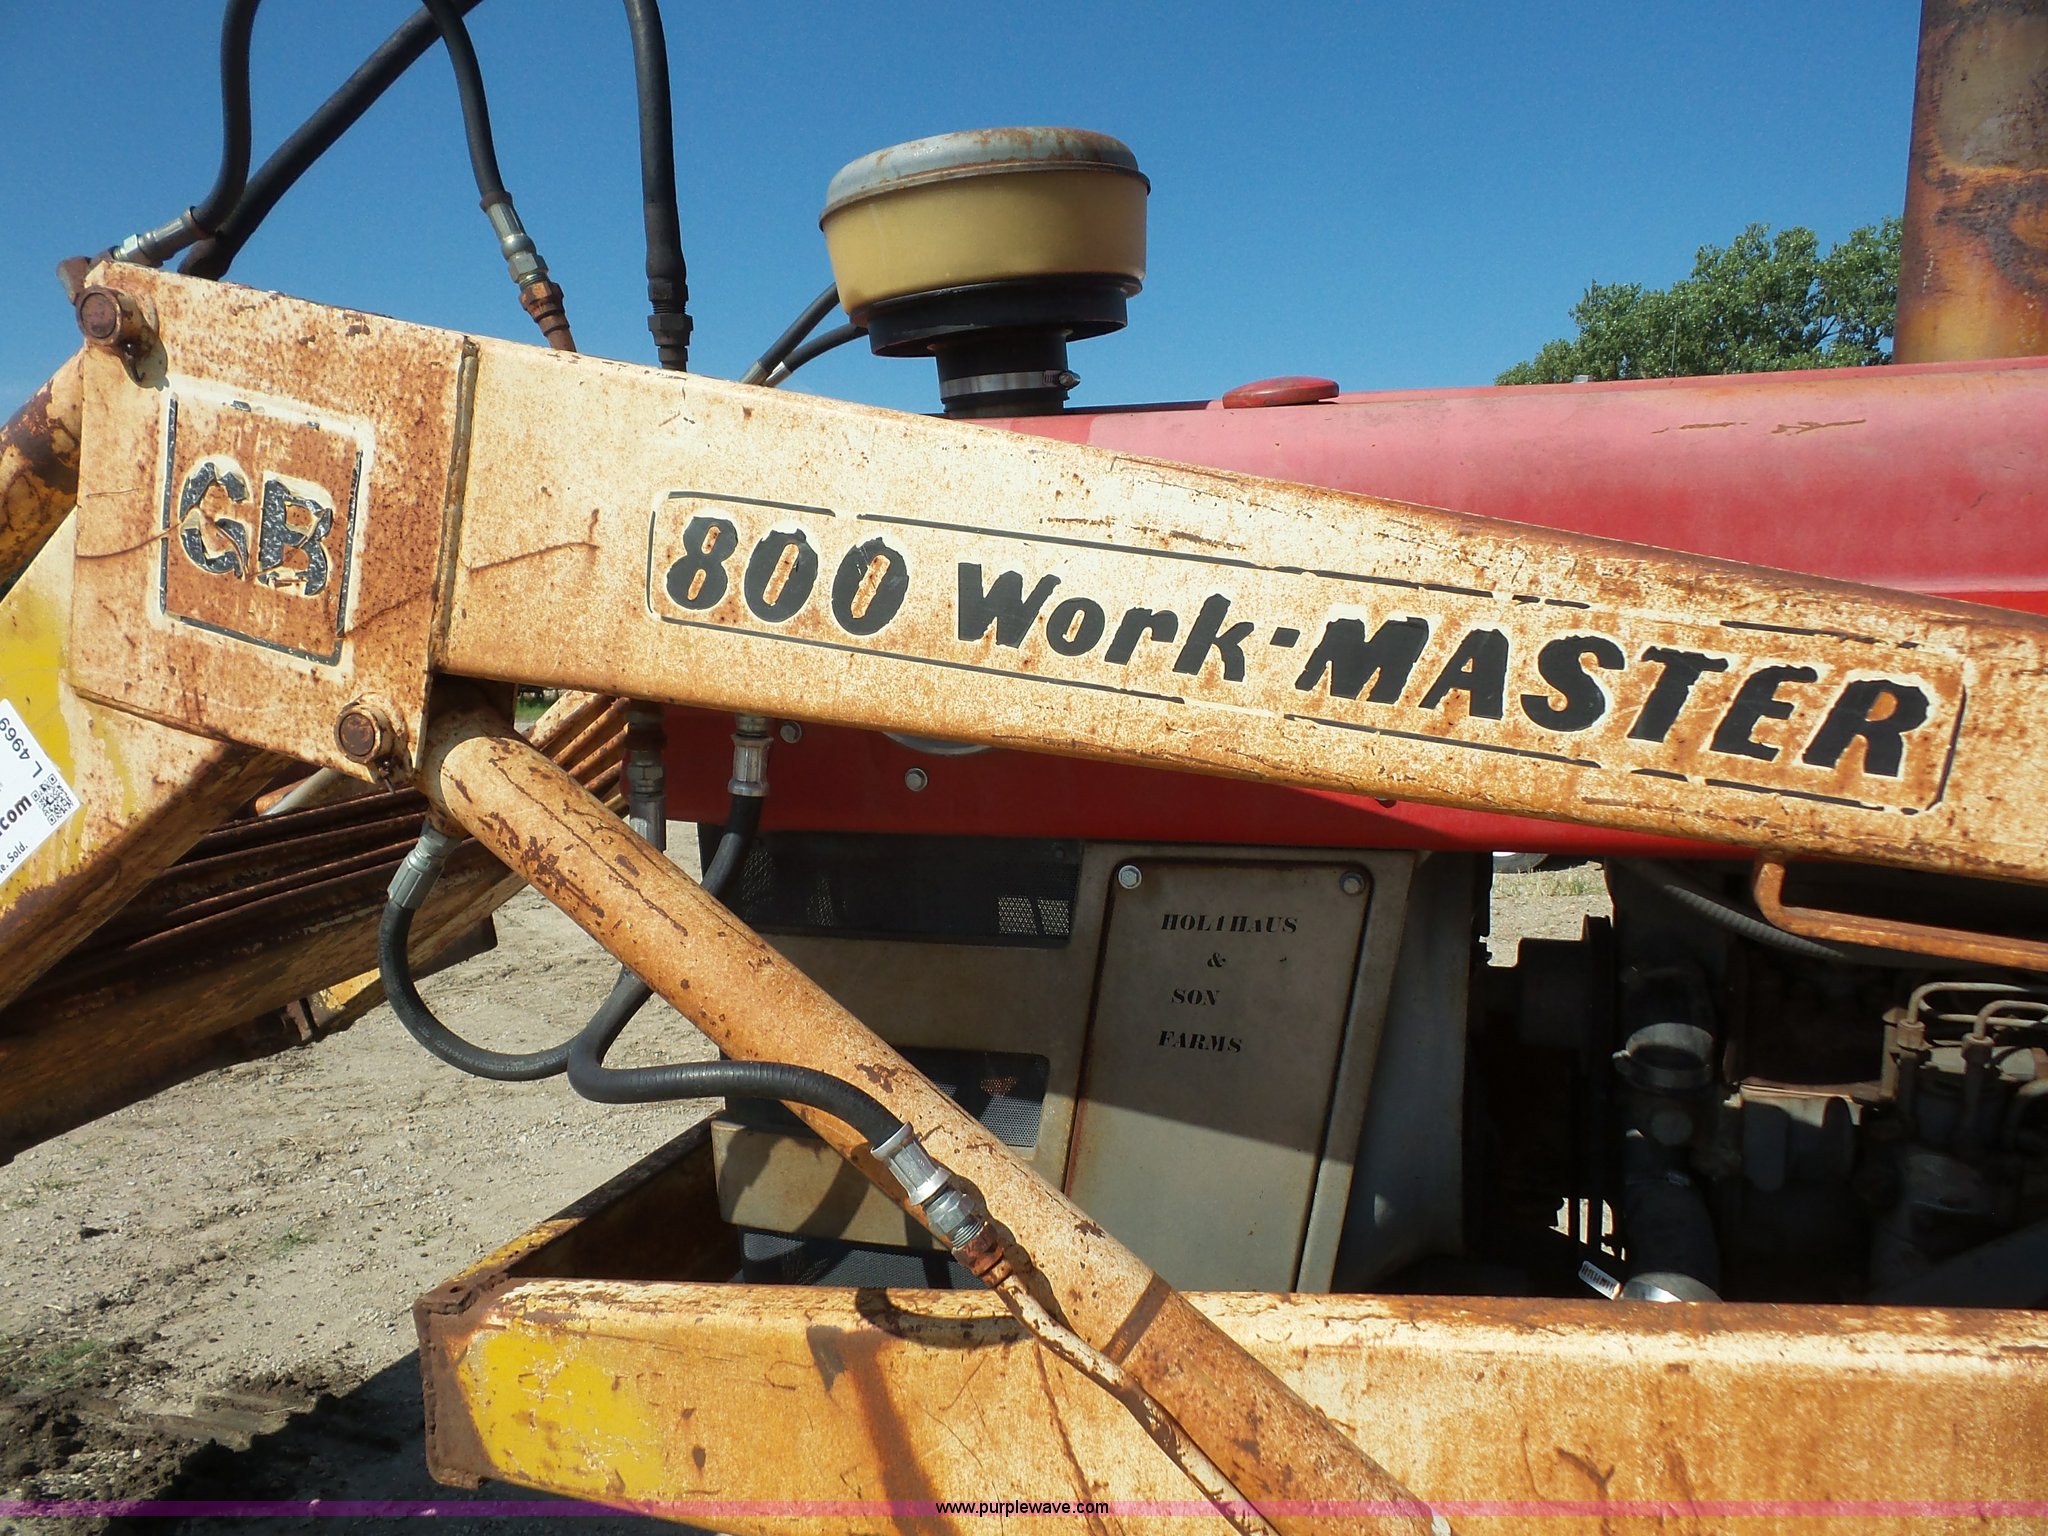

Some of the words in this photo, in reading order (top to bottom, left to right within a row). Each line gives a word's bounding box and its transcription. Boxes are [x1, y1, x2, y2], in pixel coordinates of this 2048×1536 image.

[177, 457, 333, 597] GB
[666, 515, 909, 636] 800
[0, 717, 31, 759] 4969
[6, 841, 29, 863] Sold.
[1206, 952, 1227, 968] &
[1171, 988, 1220, 1006] SON
[1158, 1030, 1242, 1053] FARMS
